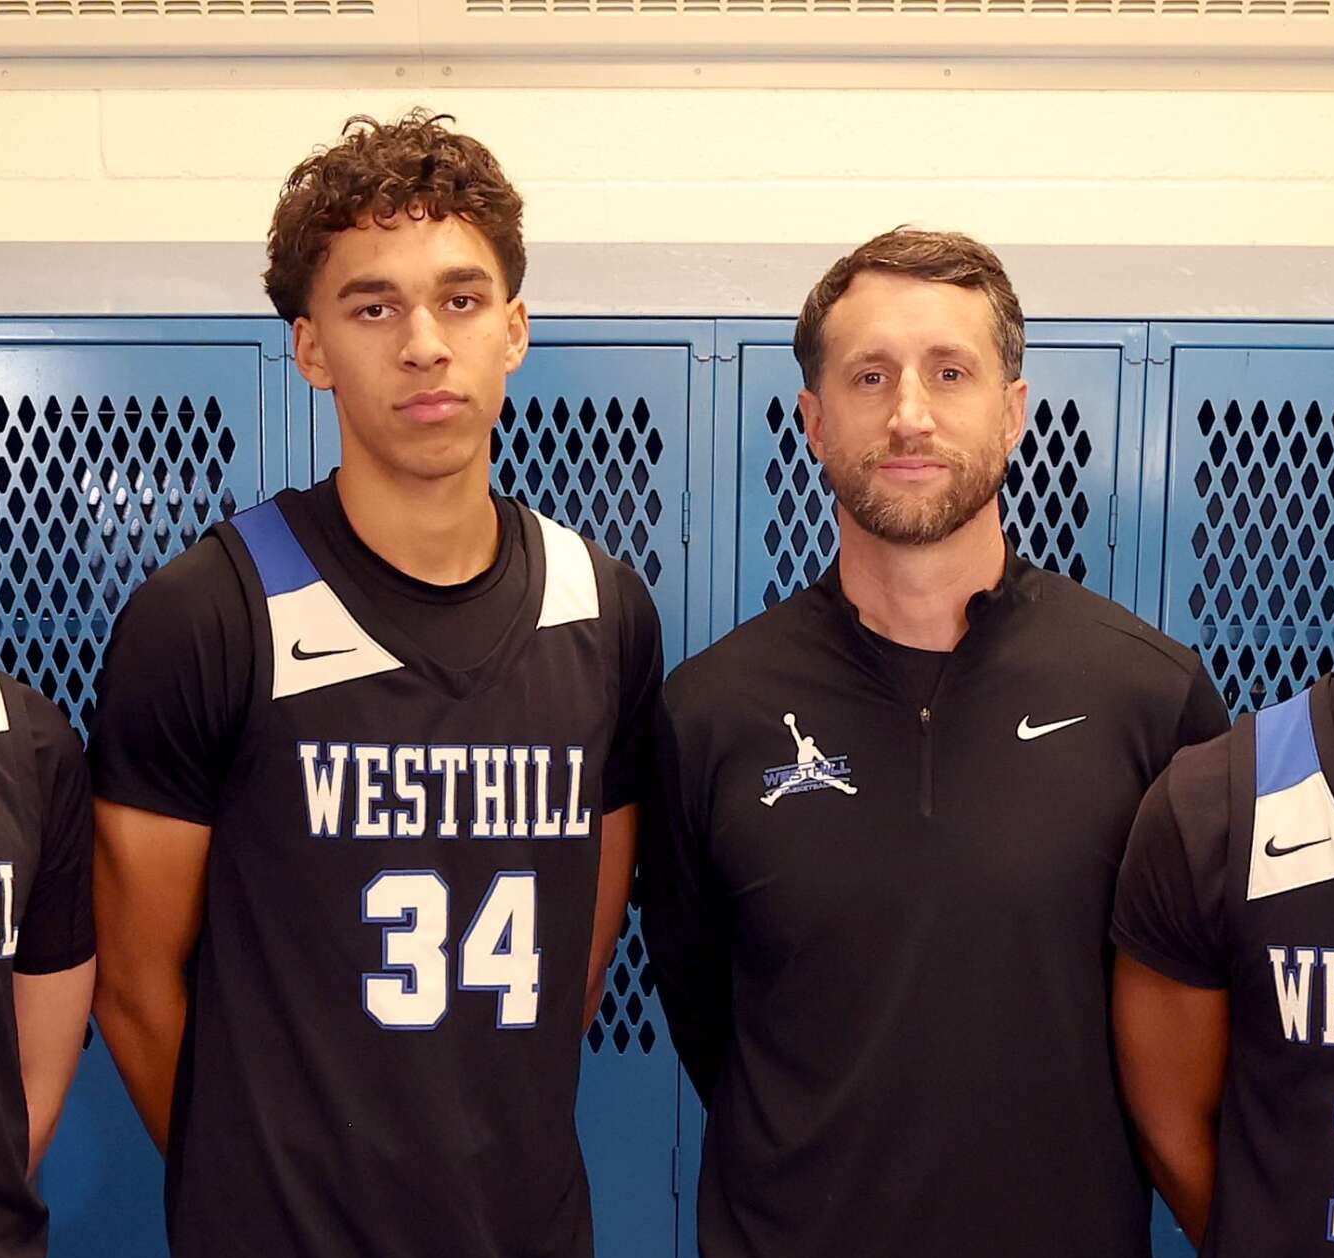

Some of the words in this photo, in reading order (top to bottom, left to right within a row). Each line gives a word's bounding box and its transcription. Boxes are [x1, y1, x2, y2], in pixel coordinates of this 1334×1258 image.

[297, 742, 592, 838] WESTHILL
[762, 760, 852, 787] WESTHILL
[362, 869, 541, 1029] 34
